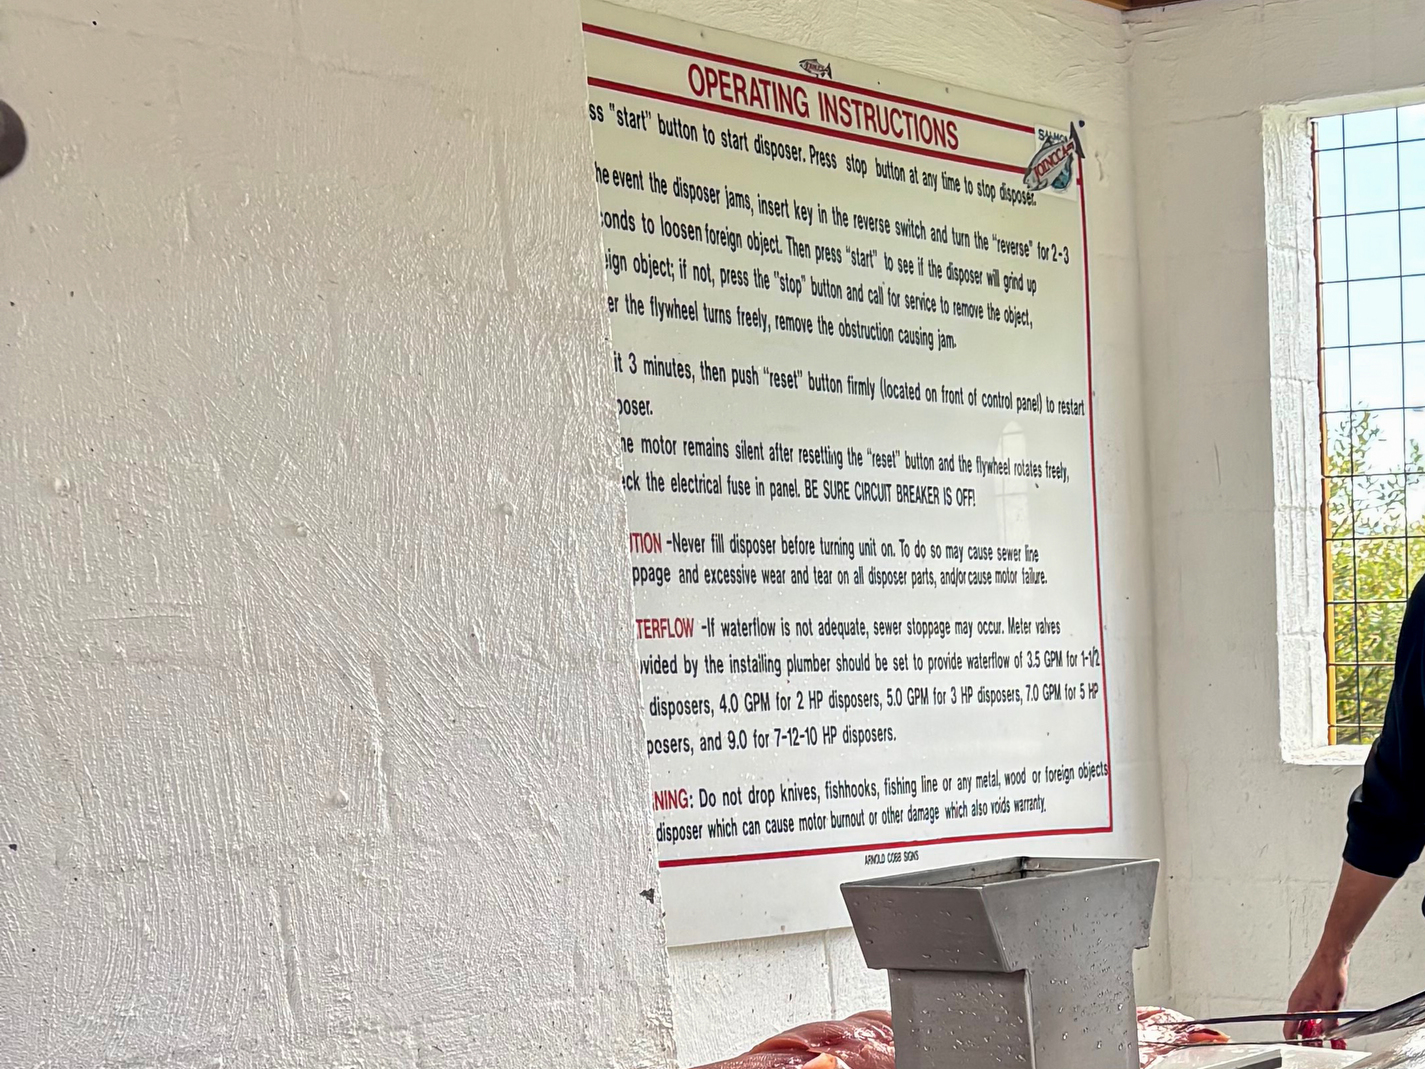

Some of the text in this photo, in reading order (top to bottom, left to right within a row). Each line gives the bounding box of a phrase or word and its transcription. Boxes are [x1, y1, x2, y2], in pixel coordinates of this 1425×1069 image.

[687, 63, 959, 150] OPERATING INSTRUCTIONS
[657, 112, 698, 142] button
[720, 128, 749, 152] start
[808, 144, 837, 169] Press
[845, 153, 867, 178] stop
[874, 157, 906, 182] button
[941, 170, 961, 193] time
[976, 179, 996, 202] stop
[612, 169, 1069, 265] event disposer jams, insert reverse switch turn 2-3
[659, 214, 1024, 293] loosen foreign object. Then press disposer grind
[632, 252, 1033, 329] object; not, press button service remove object,
[649, 295, 934, 351] flywheel turns freely, remove obstruction causing
[643, 354, 1085, 416] minutes, then push button firmly (located front control restart
[640, 434, 677, 455] motor
[682, 436, 729, 458] remains
[734, 439, 765, 460] silent
[768, 441, 794, 462] after
[904, 450, 935, 471] button
[975, 455, 1011, 477] flywheel
[1013, 459, 1042, 478] rotates
[1045, 460, 1069, 483] freely,
[670, 472, 976, 507] electrical fuse panel. SURE CIRCUIT BREAKER OFF!
[729, 533, 776, 557] disposer
[780, 534, 815, 555] before
[819, 536, 855, 560] turning
[858, 537, 877, 556] unit
[967, 545, 993, 561] cause
[996, 547, 1021, 562] sewer
[703, 563, 757, 584] excessive
[760, 569, 786, 584] wear
[812, 565, 833, 585] tear
[867, 565, 907, 589] disposer
[910, 567, 937, 589] parts,
[967, 571, 992, 585] cause
[994, 567, 1018, 584] motor
[635, 616, 1032, 640] TERFLOW waterflow adequate, sewer stoppage occur. Meter
[786, 652, 831, 677] plumber
[835, 652, 870, 672] should
[927, 651, 963, 674] provide
[966, 651, 1010, 670] waterflow
[649, 683, 1039, 718] disposers, 4.0 GPM disposers, 5.0 GPM disposers, 7.0
[727, 724, 897, 750] 9.0 7-12-10 disposers.
[652, 760, 1108, 812] NING: drop knives, fishhooks, fishing line wood foreign objects
[655, 799, 988, 844] disposer which cause motor burnout other damage which also
